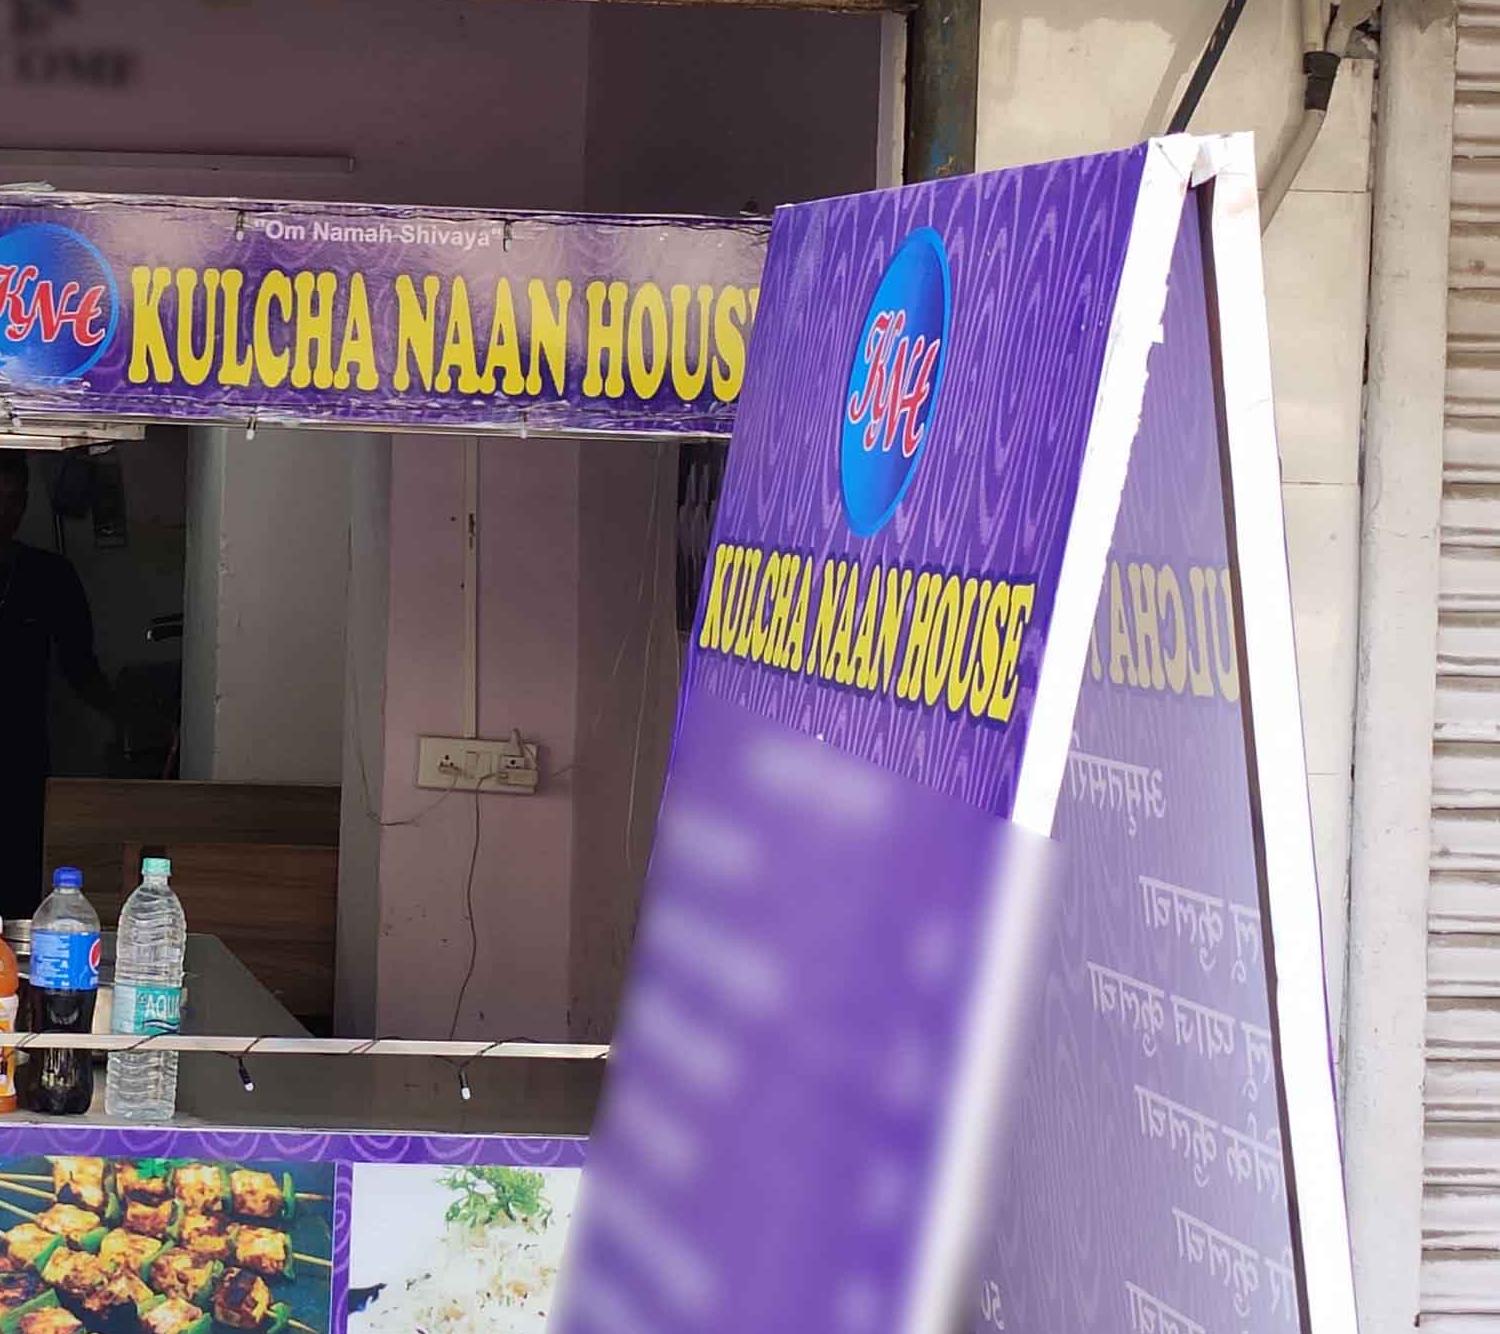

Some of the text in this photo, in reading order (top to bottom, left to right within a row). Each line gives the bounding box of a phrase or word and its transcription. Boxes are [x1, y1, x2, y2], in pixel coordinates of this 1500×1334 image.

[127, 266, 760, 403] KULCHA NAAN HOUS
[699, 543, 813, 673] KULCHA
[806, 558, 913, 694] NAAN
[896, 571, 1036, 724] HOUSE
